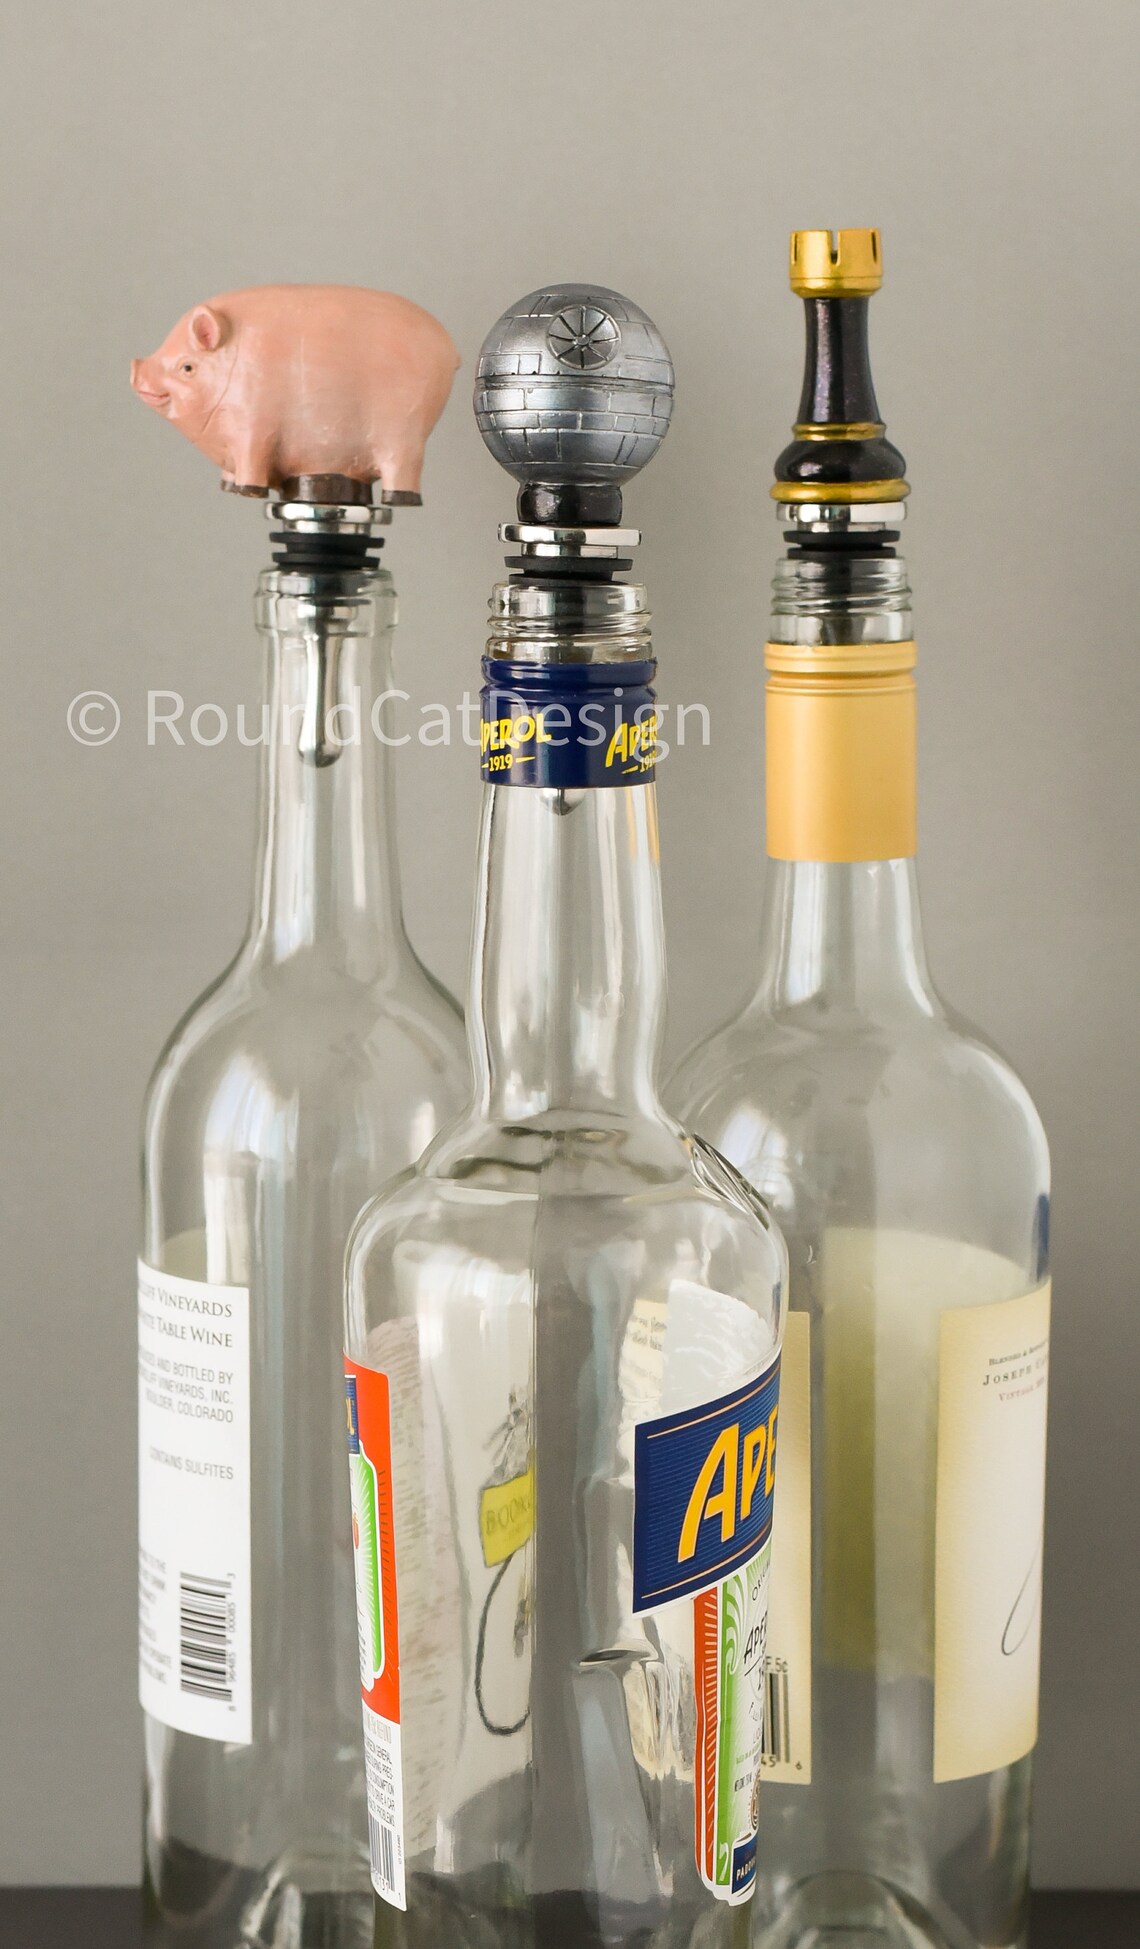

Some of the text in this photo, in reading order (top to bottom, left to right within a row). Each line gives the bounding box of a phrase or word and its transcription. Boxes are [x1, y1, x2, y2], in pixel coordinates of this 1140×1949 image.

[489, 754, 513, 772] 1919
[158, 1287, 232, 1318] VINEYARDS
[156, 1316, 187, 1340] TABLE
[190, 1325, 232, 1348] WINE
[173, 1362, 215, 1383] BOTTLED
[218, 1371, 233, 1385] BY
[983, 1365, 1032, 1386] JOSEPH
[211, 1389, 233, 1405] INC.
[177, 1400, 233, 1423] COLORADO
[185, 1457, 234, 1480] SULFITES
